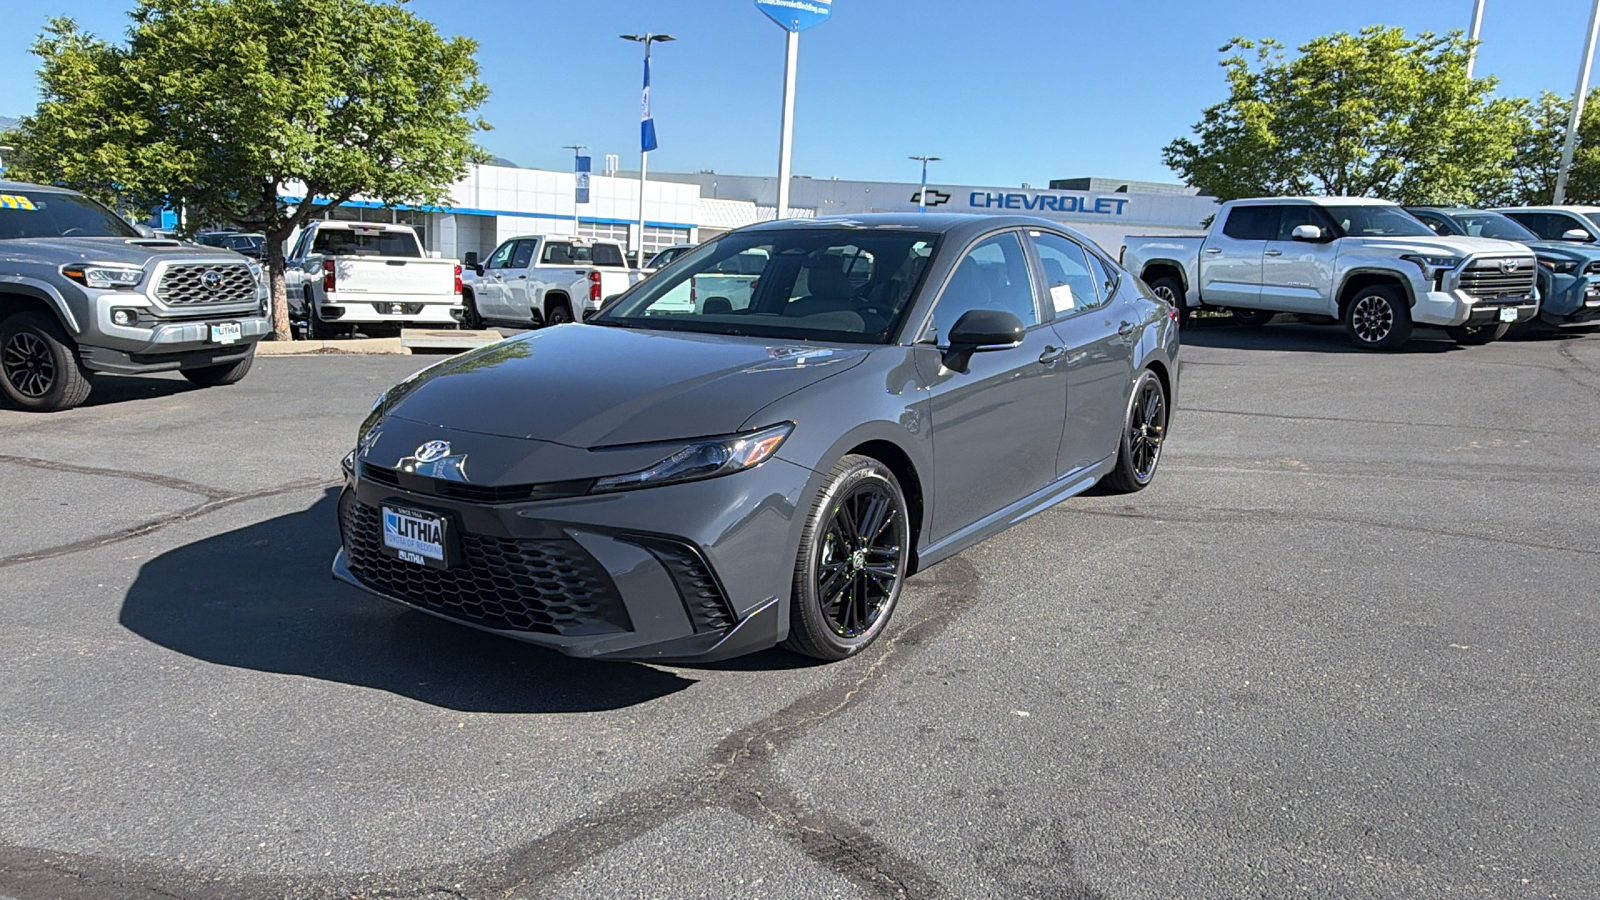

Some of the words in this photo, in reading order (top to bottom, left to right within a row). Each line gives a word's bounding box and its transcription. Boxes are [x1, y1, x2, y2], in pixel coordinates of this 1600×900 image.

[970, 191, 1129, 215] CHEVROLET
[219, 326, 239, 335] LITHIA
[397, 516, 443, 546] LITHIA
[386, 533, 407, 545] TOYOTA
[407, 539, 415, 547] OF
[416, 541, 443, 556] REDDING
[404, 551, 425, 566] LITHIA
